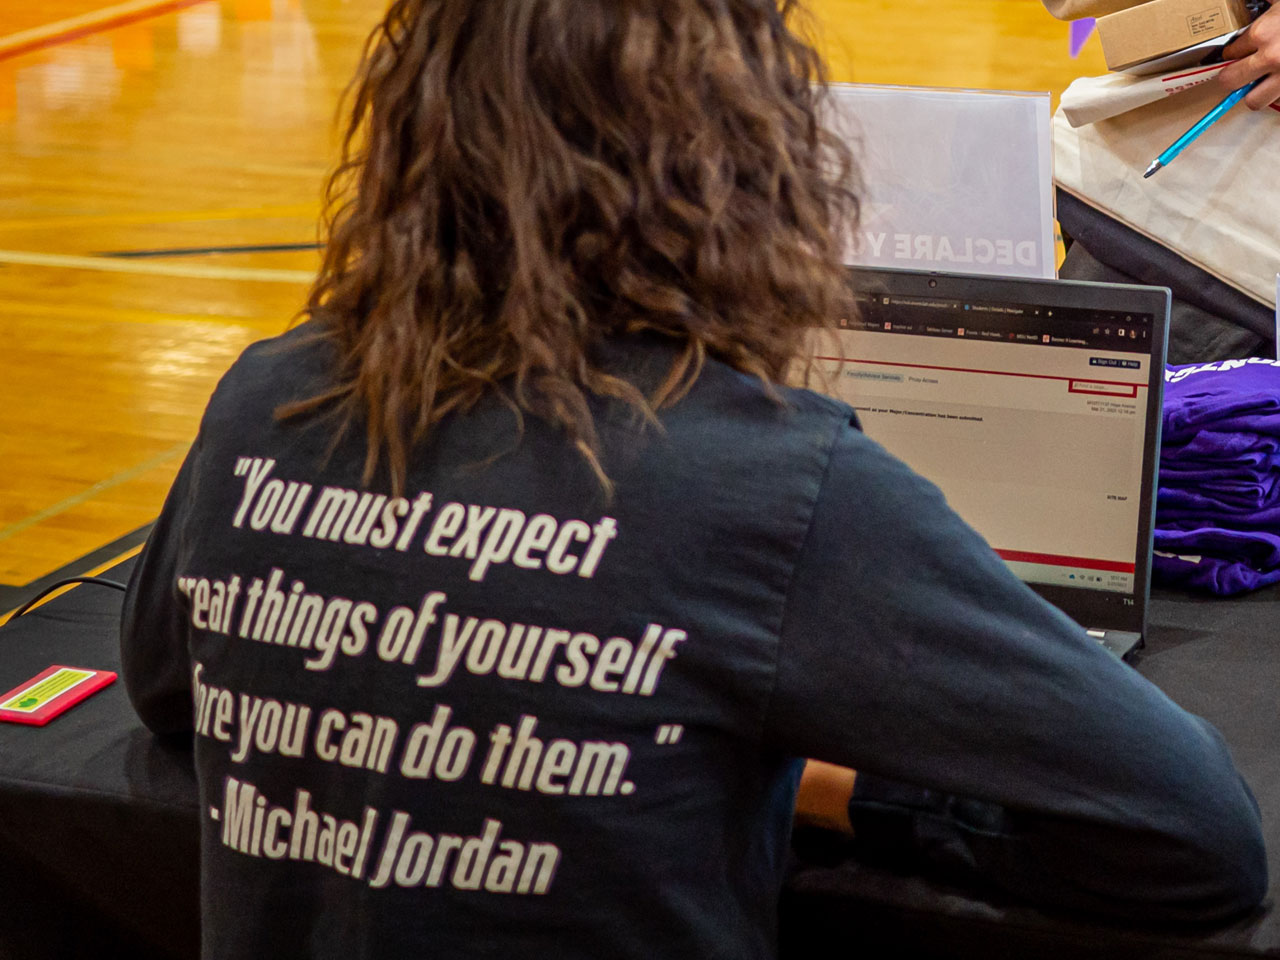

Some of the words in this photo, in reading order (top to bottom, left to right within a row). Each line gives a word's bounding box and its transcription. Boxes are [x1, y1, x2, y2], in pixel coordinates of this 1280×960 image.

[303, 484, 433, 552] must
[424, 501, 618, 581] expect
[178, 575, 242, 636] reat
[238, 567, 377, 671] things
[380, 591, 447, 665] of
[417, 622, 687, 697] yourself
[232, 692, 311, 763] you
[316, 707, 400, 774] can
[400, 704, 476, 782] do
[211, 777, 378, 881] -Michael
[368, 812, 562, 895] Jordan
